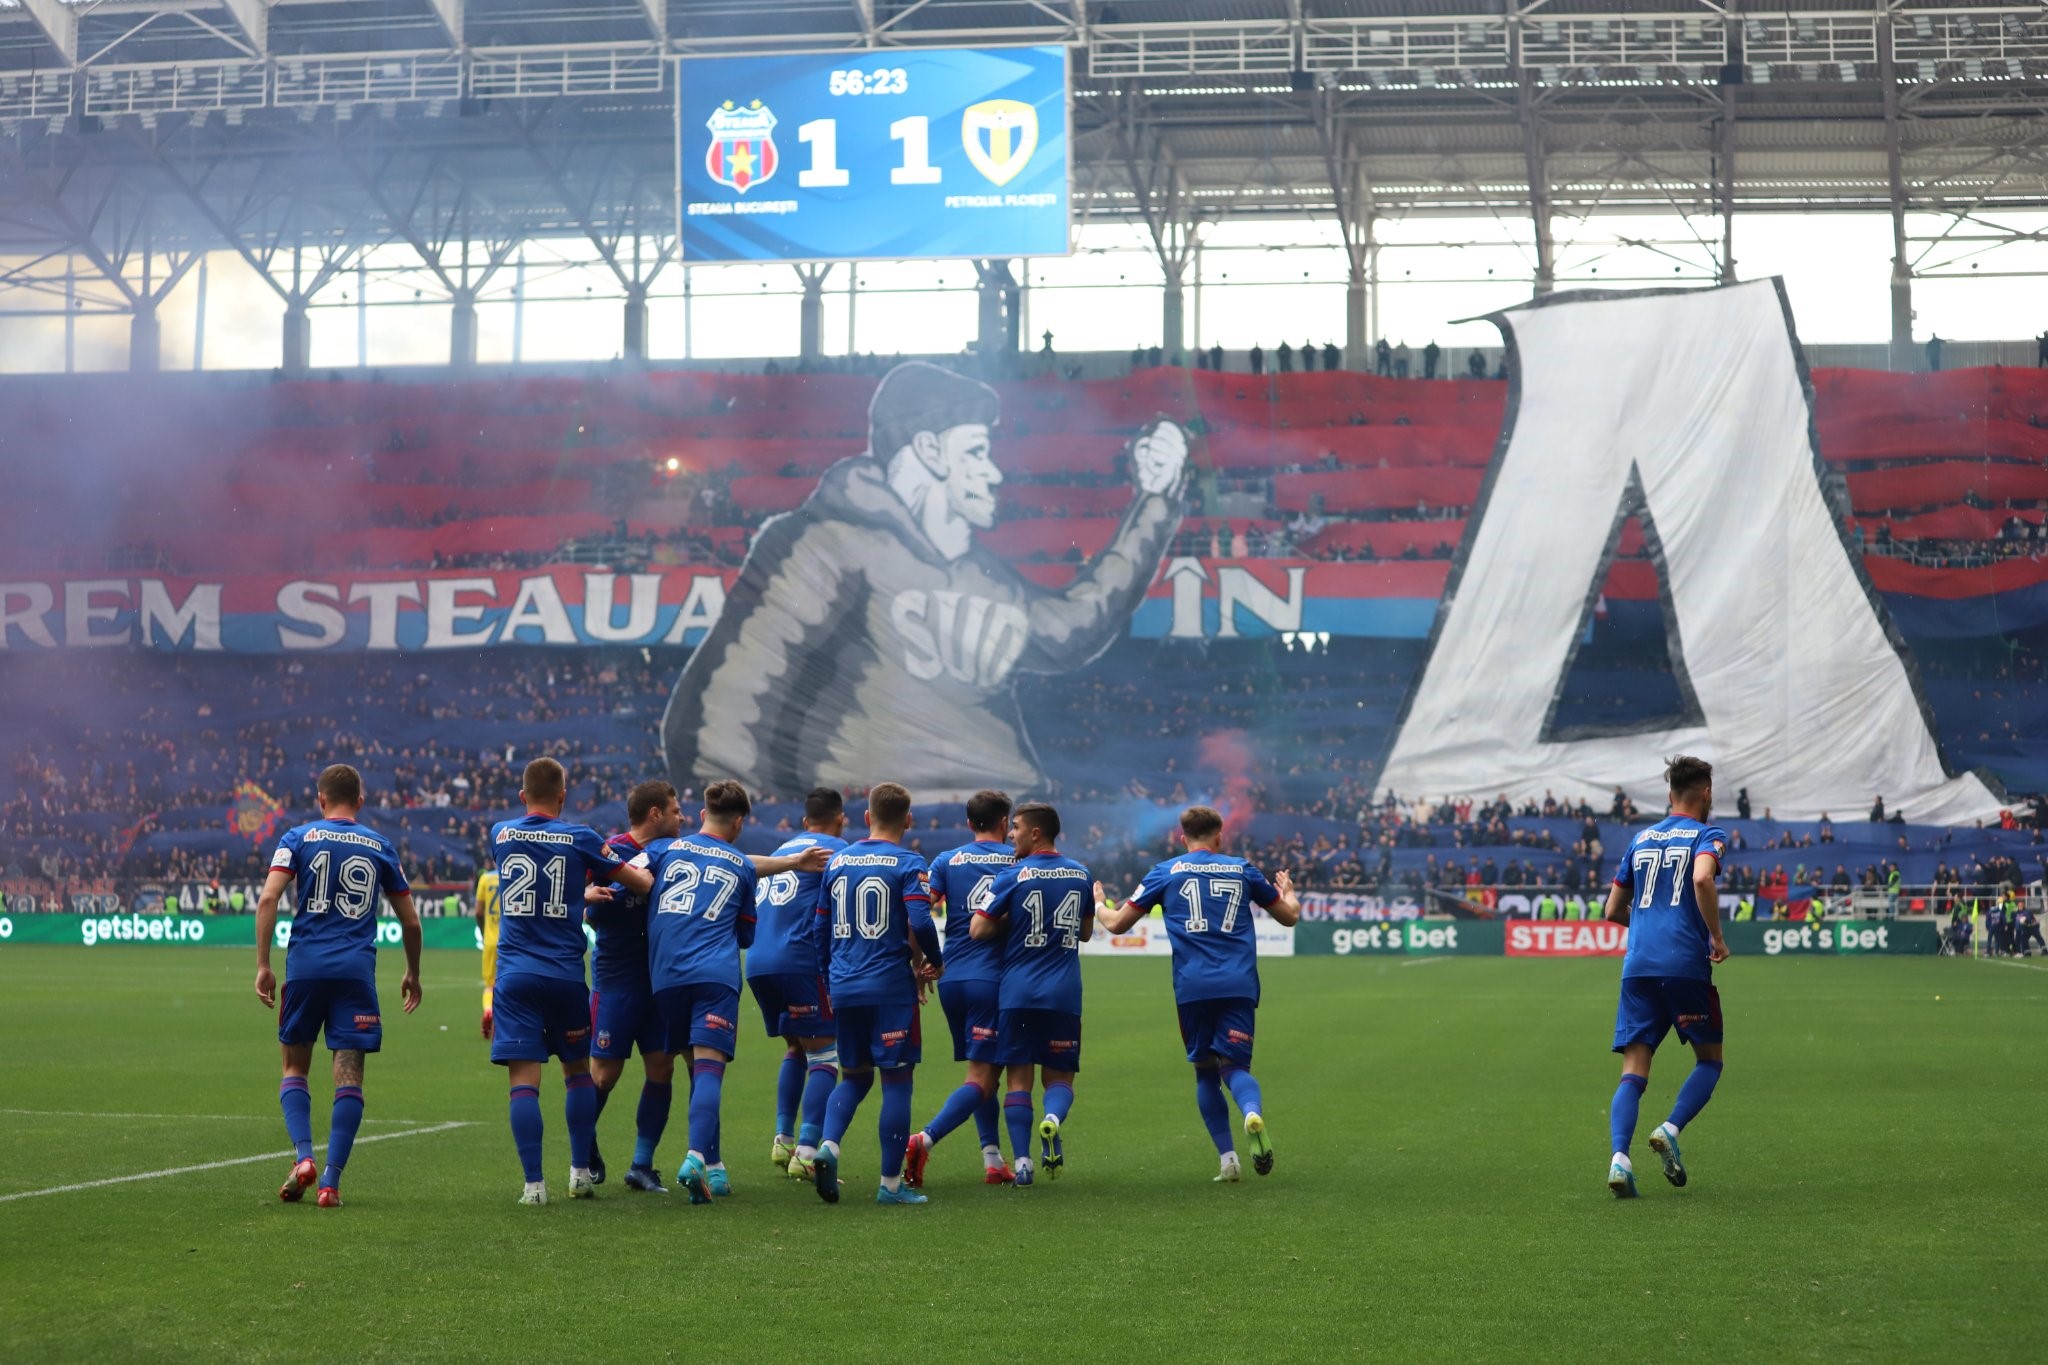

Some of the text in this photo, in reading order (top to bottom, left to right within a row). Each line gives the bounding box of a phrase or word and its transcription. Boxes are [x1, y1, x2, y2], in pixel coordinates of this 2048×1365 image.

[829, 68, 908, 96] 56:23
[798, 116, 942, 187] 1 1
[687, 203, 733, 215] STEAUA
[277, 573, 726, 650] STEAUA
[1163, 557, 1306, 637] ÎN
[319, 829, 381, 850] Porotherm
[507, 829, 572, 844] Porotherm
[683, 842, 743, 865] Porotherm
[841, 855, 896, 866] Porotherm
[1184, 862, 1242, 873] Porotherm
[307, 851, 377, 920] 19
[501, 853, 568, 918] 21
[1031, 867, 1087, 879] Porotherm
[1634, 846, 1691, 909] 77
[657, 859, 739, 921] 27
[831, 876, 890, 939] 10
[1022, 890, 1081, 949] 14
[1179, 878, 1243, 933] 17
[81, 913, 204, 946] getsbet.ro
[1409, 924, 1457, 948] bet
[1840, 923, 1889, 949] bet
